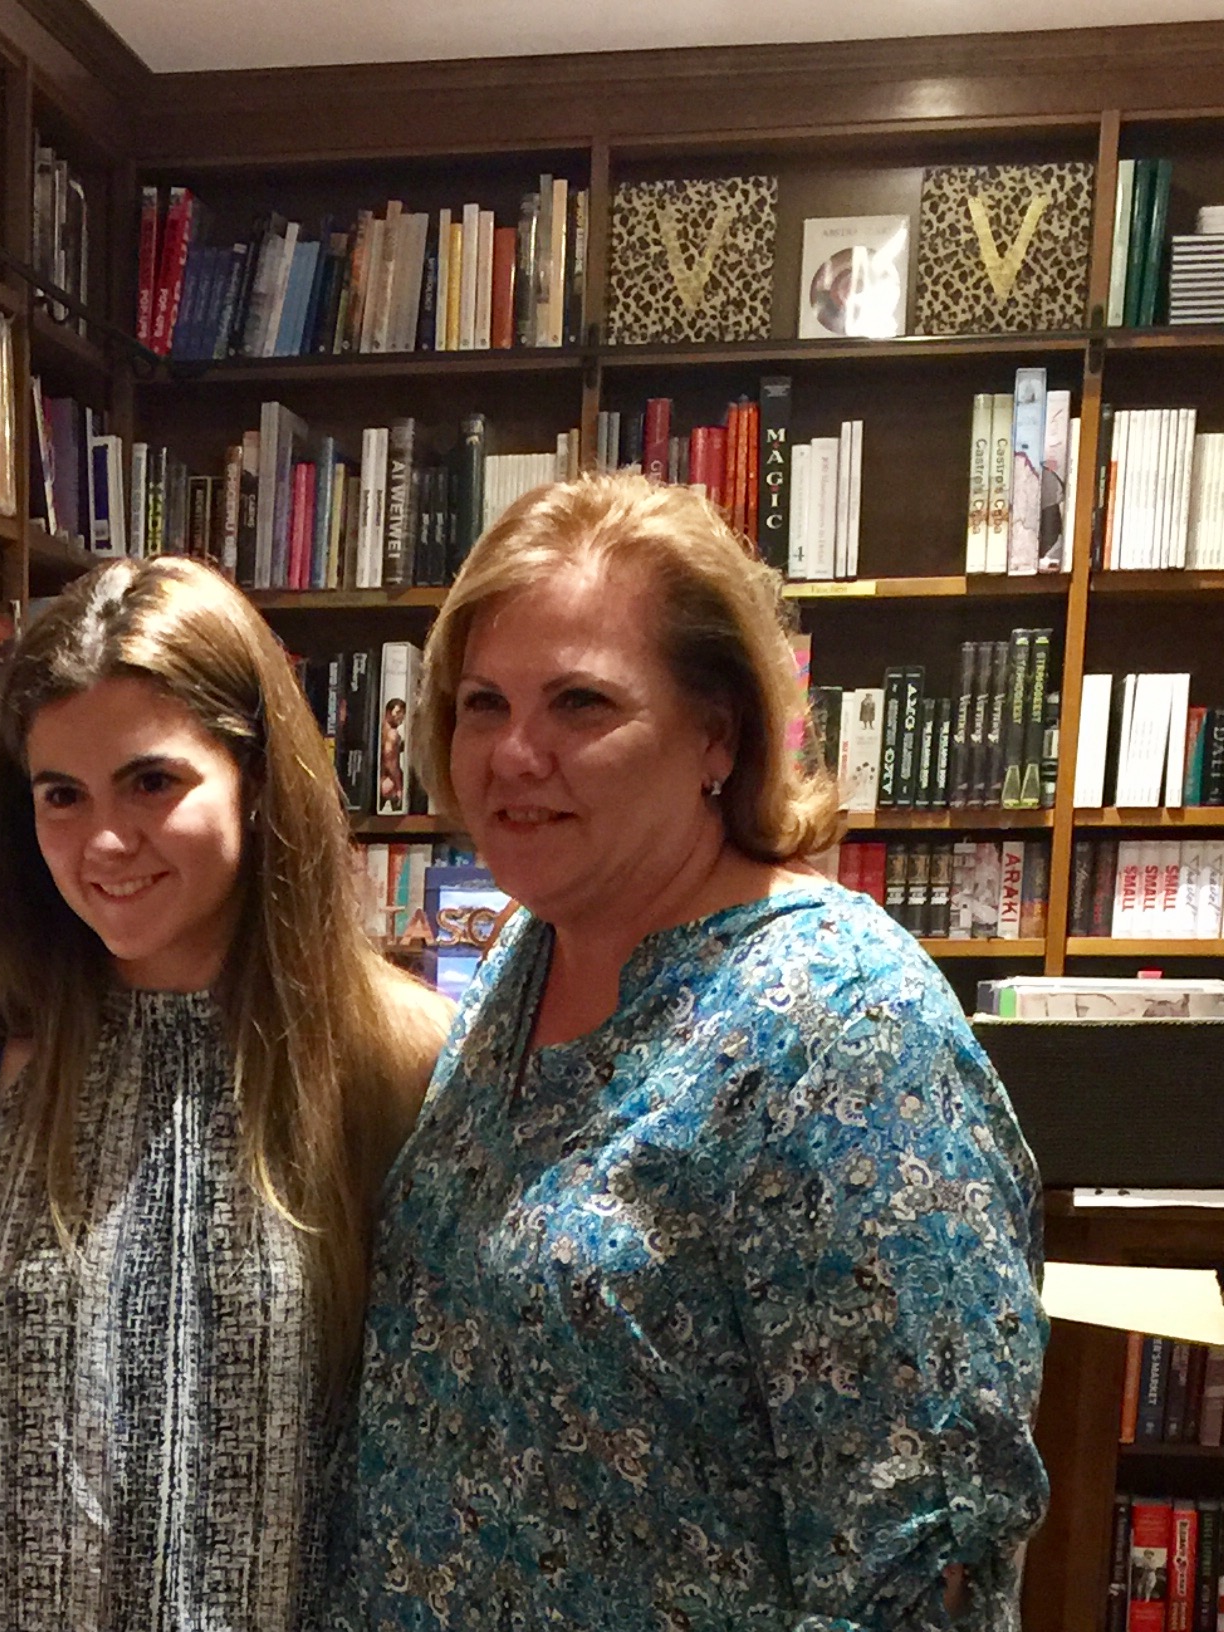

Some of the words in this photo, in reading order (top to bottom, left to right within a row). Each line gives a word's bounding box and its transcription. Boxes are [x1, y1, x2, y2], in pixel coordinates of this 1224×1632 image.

[391, 460, 406, 480] AI
[765, 427, 786, 530] MAGIC
[973, 437, 988, 495] Castro's
[993, 437, 1008, 495] Castro's
[387, 484, 407, 559] WEIWEI
[971, 498, 985, 536] Cuba
[993, 498, 1006, 535] Cuba
[1001, 853, 1021, 924] ARAKI
[1121, 864, 1138, 912] SMALL
[1142, 864, 1159, 912] SMALL
[1163, 864, 1180, 912] SMALL
[1148, 1362, 1160, 1406] MARKET
